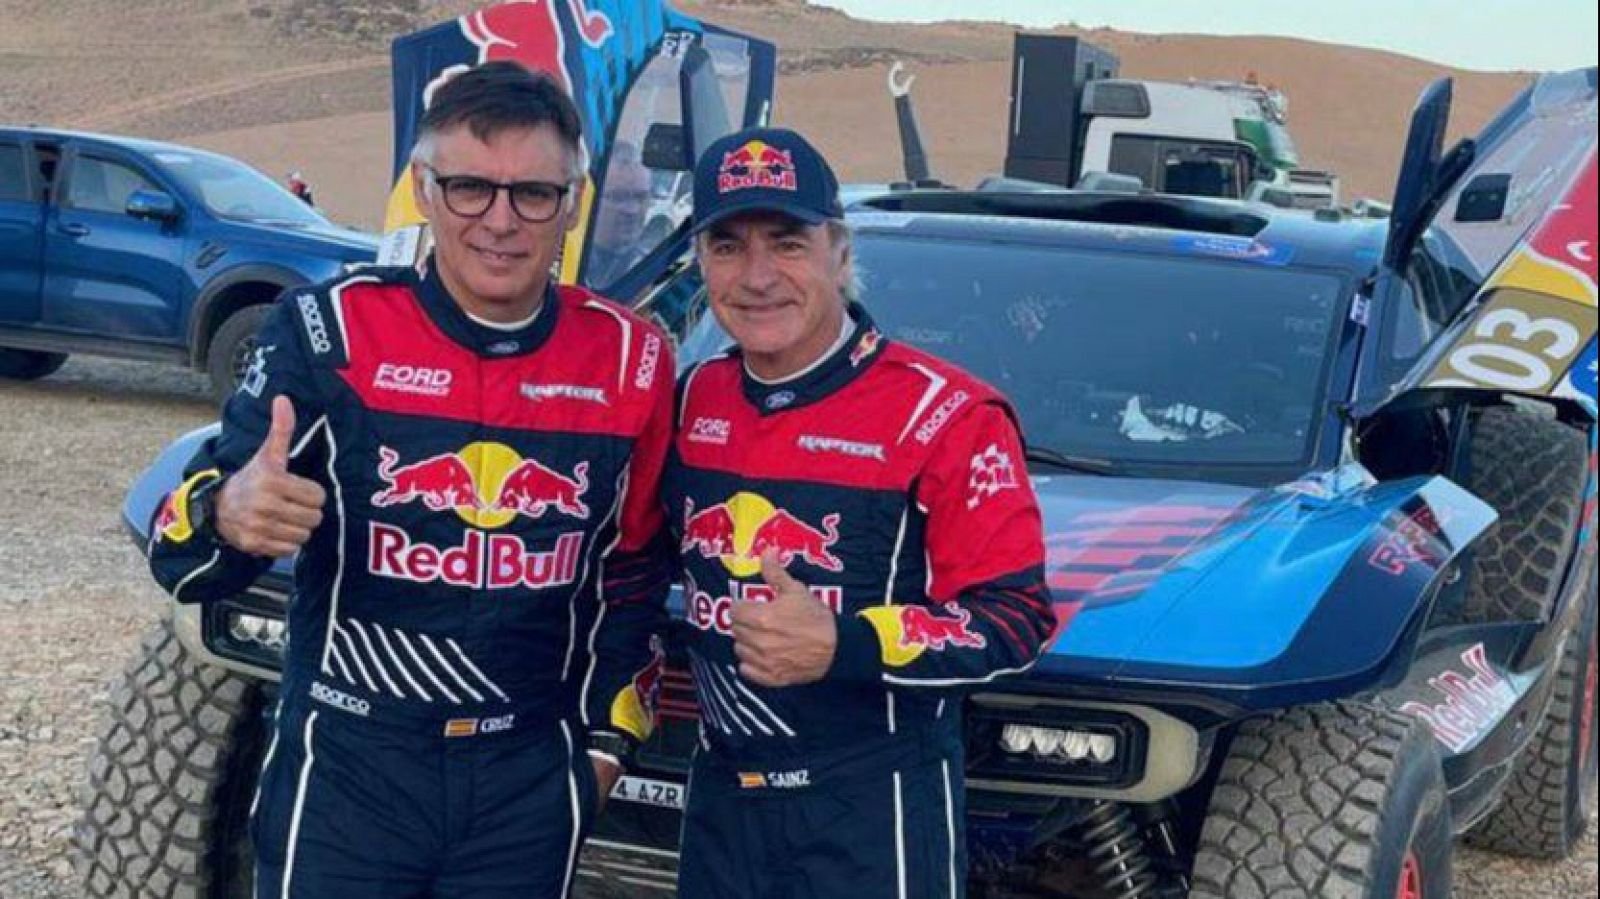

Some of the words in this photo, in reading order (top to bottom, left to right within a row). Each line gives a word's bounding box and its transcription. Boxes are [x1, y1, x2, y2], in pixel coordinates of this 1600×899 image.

[719, 167, 757, 192] Red
[1424, 307, 1580, 391] 03
[376, 362, 453, 387] FORD
[692, 416, 731, 436] FORD
[368, 520, 484, 589] Red
[486, 531, 585, 589] Bull
[480, 713, 514, 733] CRUZ
[767, 769, 811, 789] SAINZ
[638, 783, 680, 806] AZR
